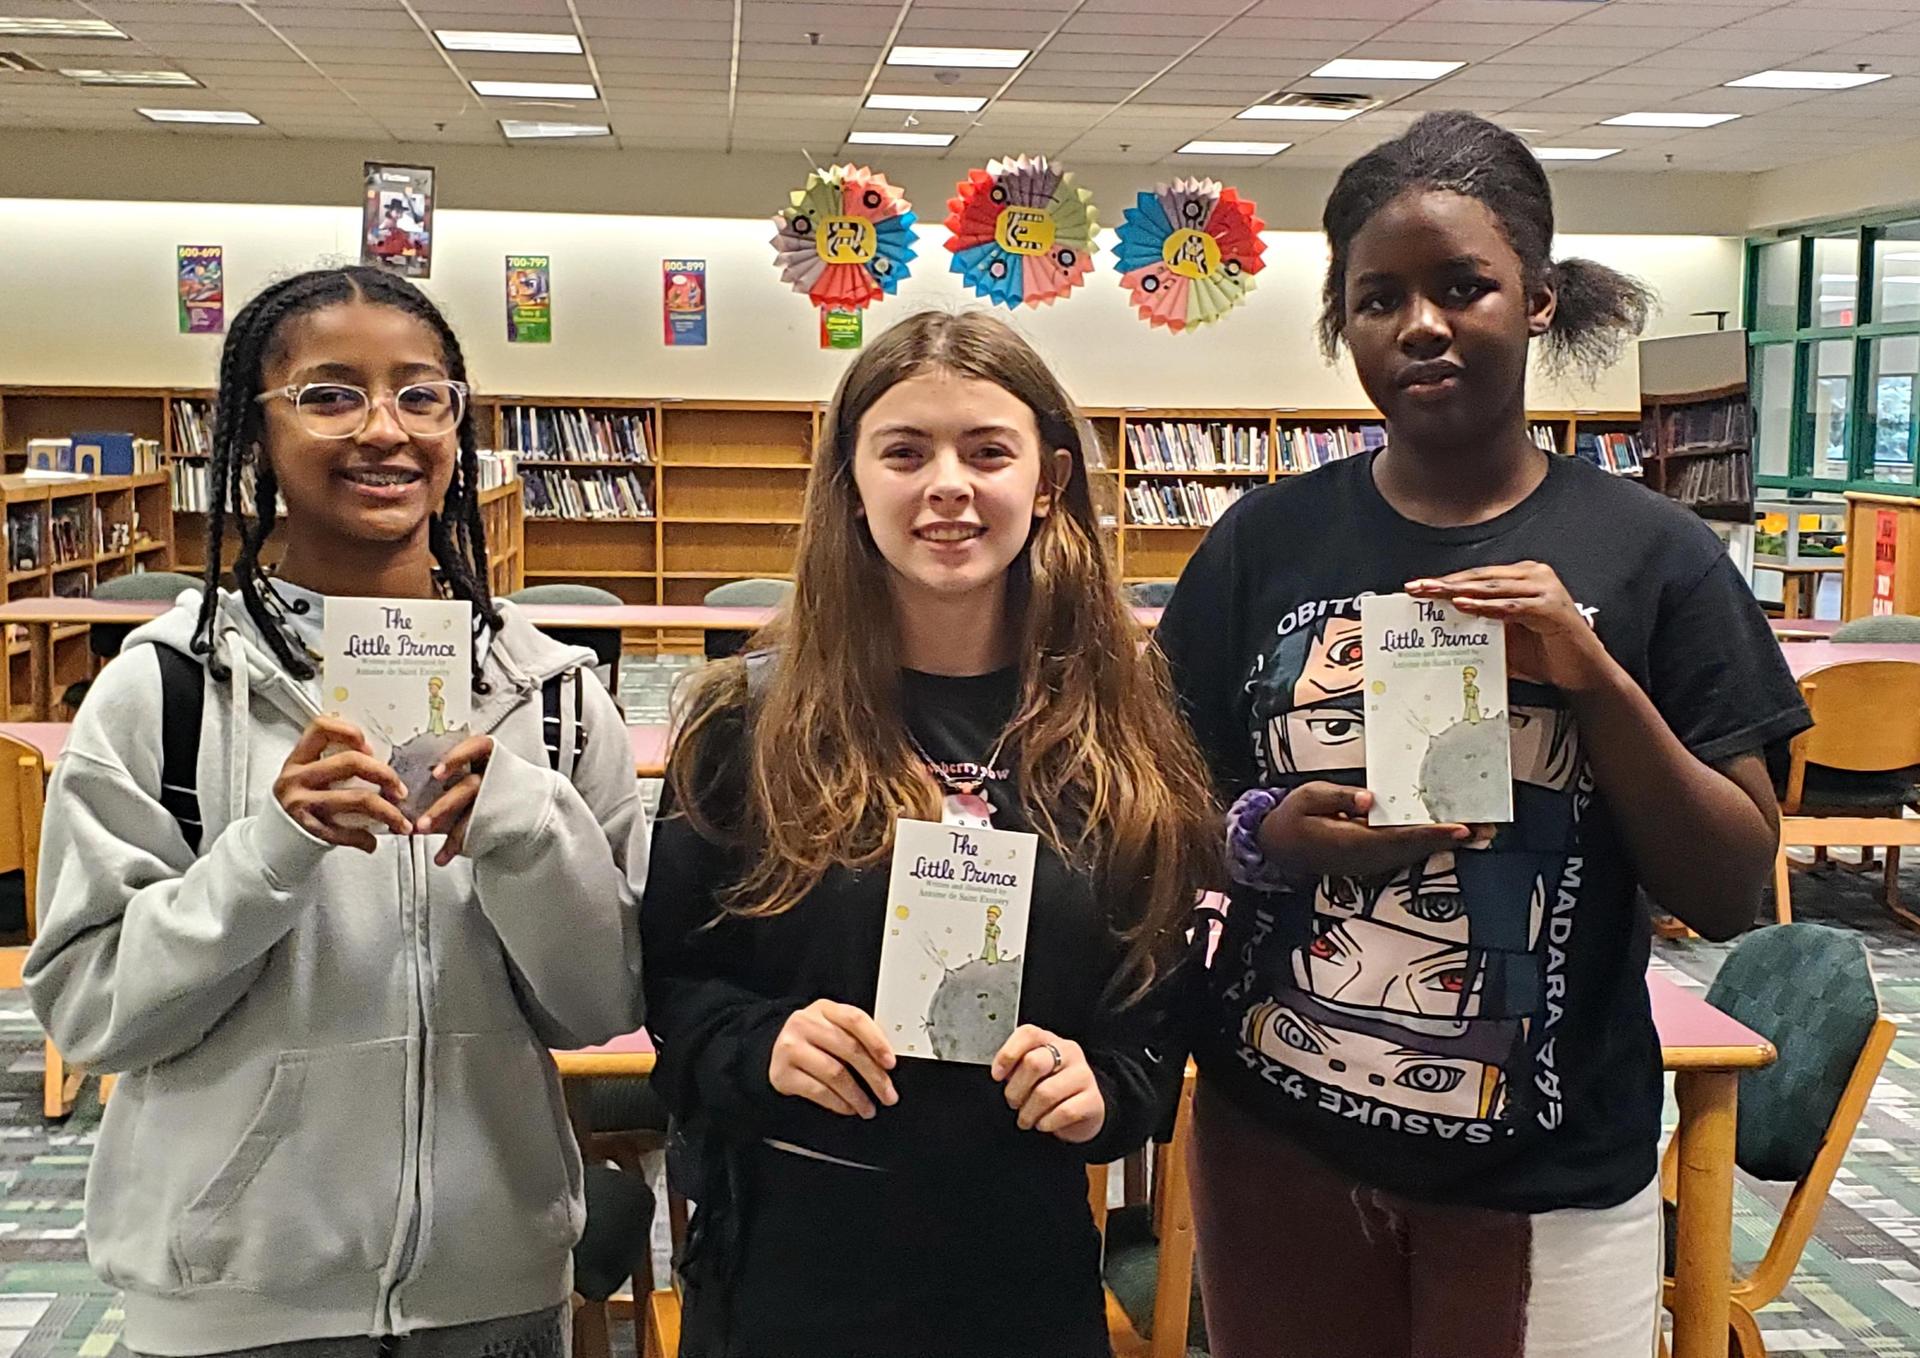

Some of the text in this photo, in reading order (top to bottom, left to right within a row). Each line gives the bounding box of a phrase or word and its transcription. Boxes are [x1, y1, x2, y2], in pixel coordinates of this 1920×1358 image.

[179, 247, 220, 258] 600-699
[827, 211, 1207, 275] R E A
[508, 257, 547, 267] 700-799
[664, 261, 705, 272] 800-899
[380, 607, 413, 630] The
[1413, 600, 1445, 622] The
[344, 634, 456, 658] Little Prince
[1380, 627, 1489, 652] Little Prince
[949, 832, 978, 857] The
[909, 857, 1018, 888] Little Prince
[1544, 856, 1584, 1029] MADARA
[1318, 1086, 1494, 1144] SASUKE
